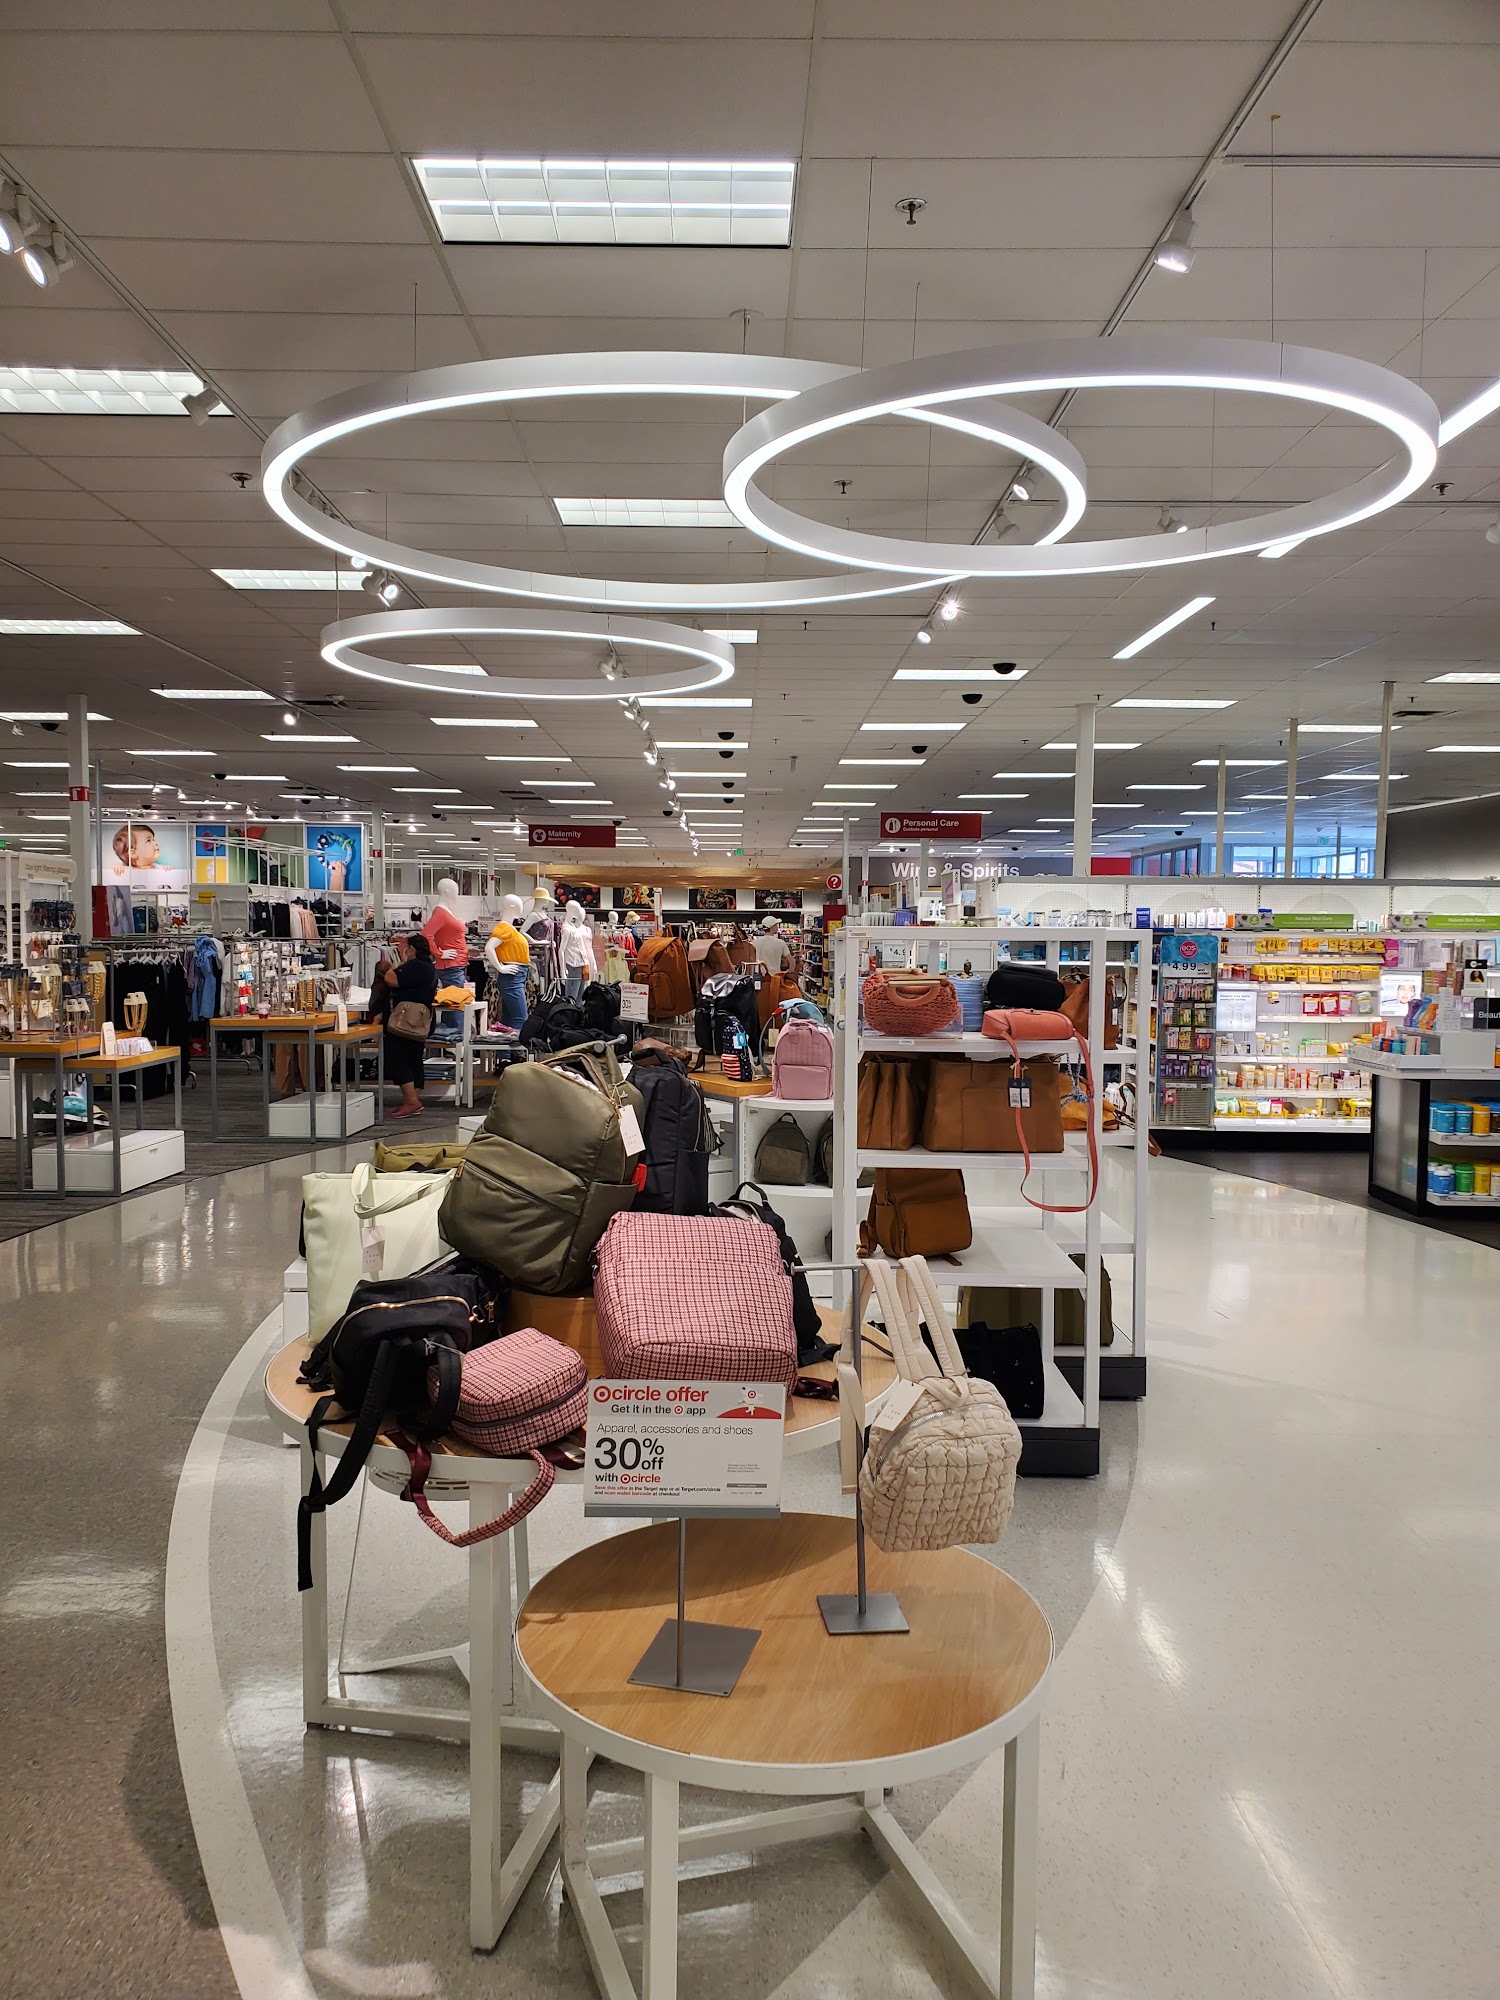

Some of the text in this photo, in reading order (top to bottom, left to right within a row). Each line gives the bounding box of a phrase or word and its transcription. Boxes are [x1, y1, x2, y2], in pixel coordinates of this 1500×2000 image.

[548, 830, 581, 838] Maternity
[961, 863, 1020, 881] Spirits
[612, 1385, 709, 1402] circle offer
[611, 1404, 706, 1416] Get it in the app
[597, 1423, 753, 1435] Apparel, accessories and shoes
[641, 1457, 664, 1470] off
[595, 1473, 661, 1483] with circle
